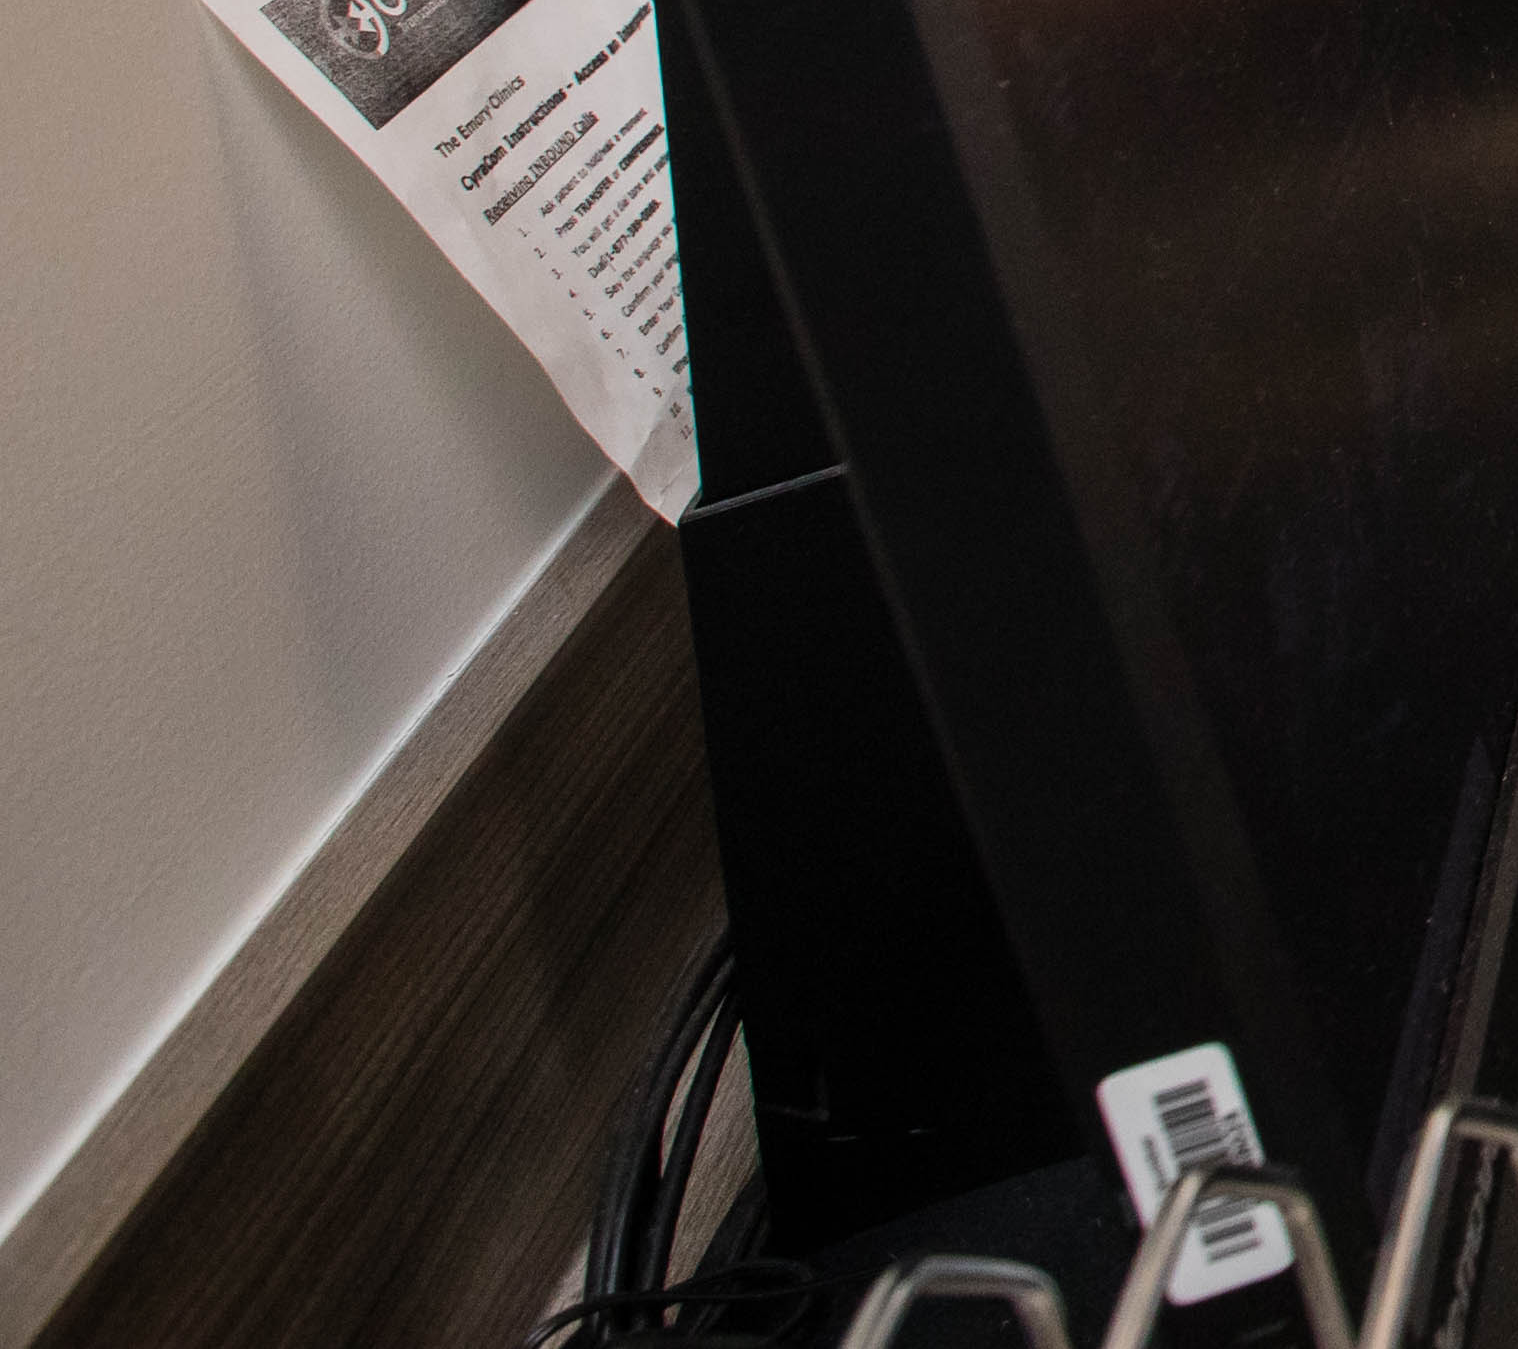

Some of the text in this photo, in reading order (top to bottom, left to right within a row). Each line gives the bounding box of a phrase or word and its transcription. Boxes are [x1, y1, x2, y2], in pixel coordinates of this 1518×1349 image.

[434, 75, 526, 159] The Emory Clinics
[460, 145, 508, 191] CyraCom
[502, 87, 568, 149] Instructions
[483, 110, 600, 226] Receiving INBOUND Calls
[555, 215, 578, 238] Press
